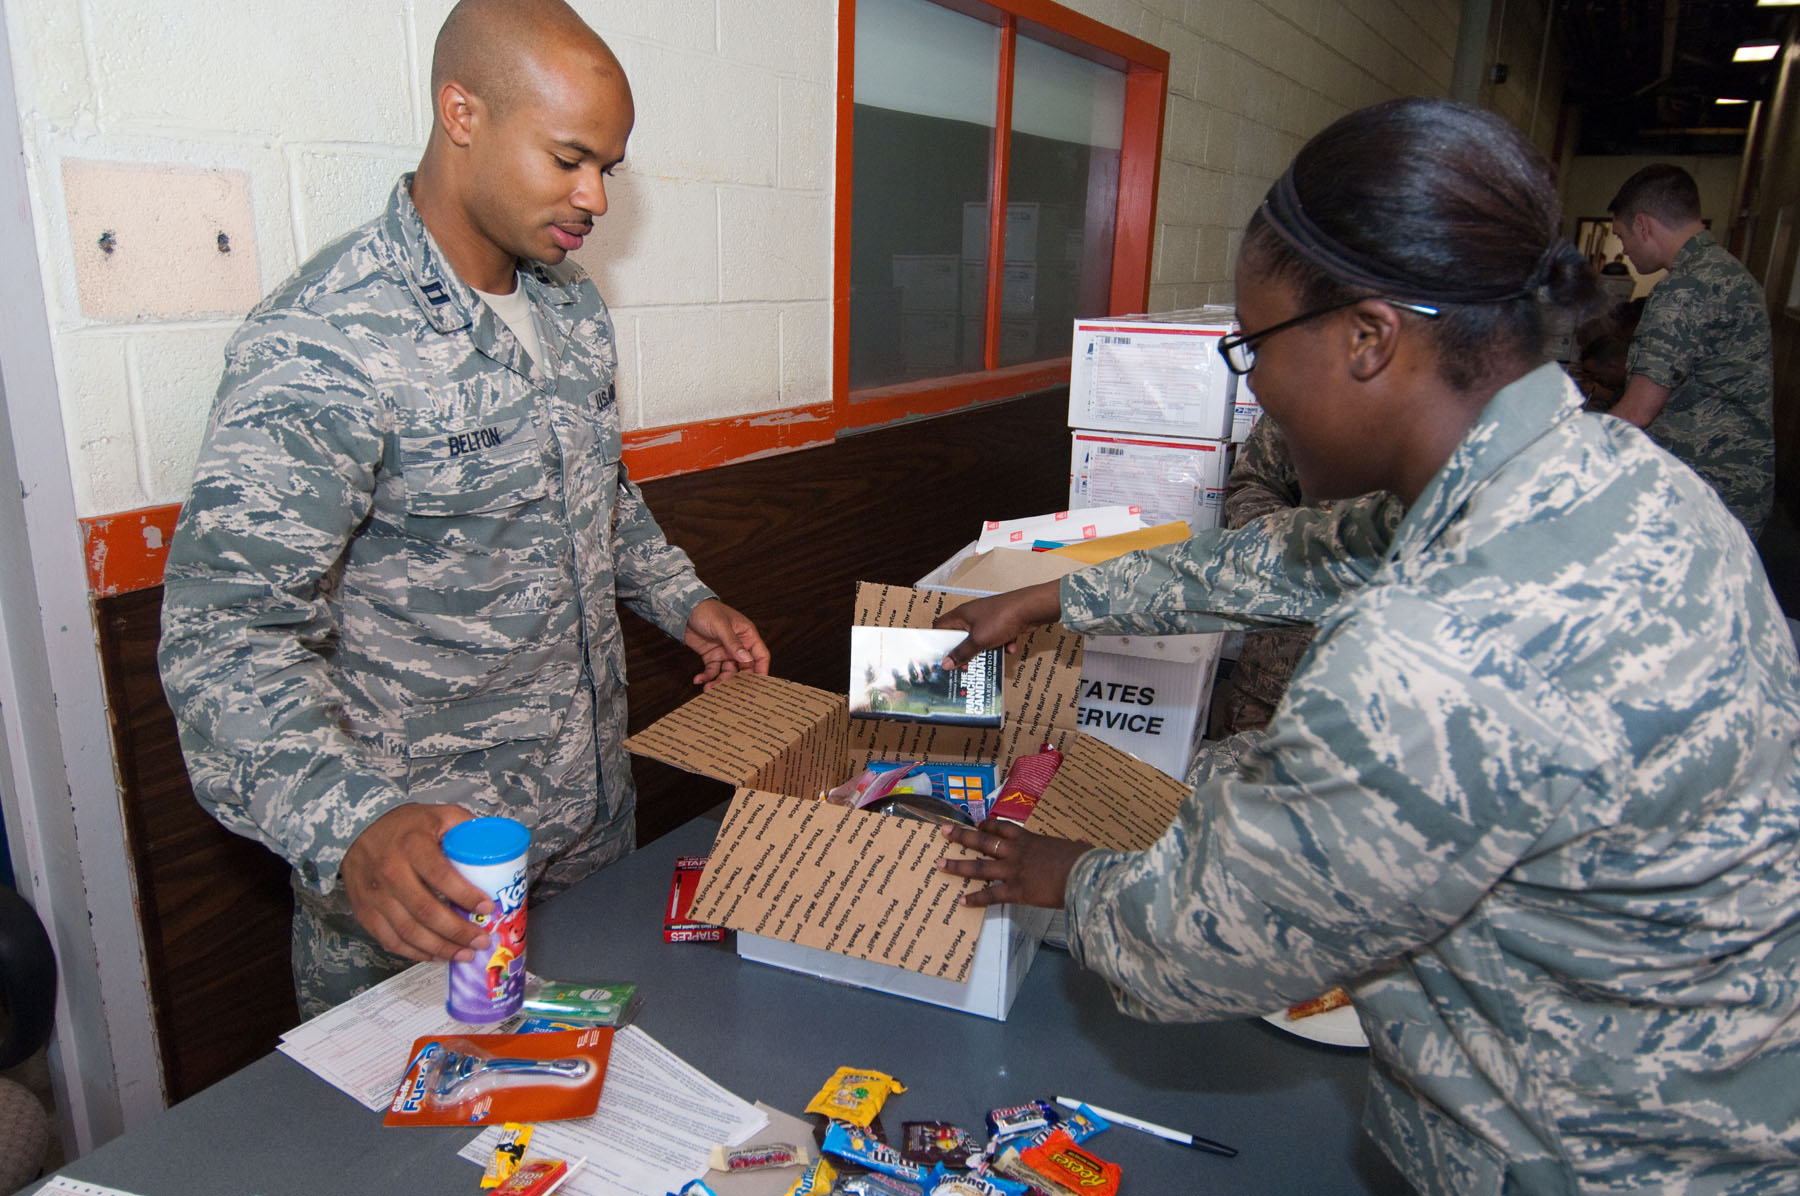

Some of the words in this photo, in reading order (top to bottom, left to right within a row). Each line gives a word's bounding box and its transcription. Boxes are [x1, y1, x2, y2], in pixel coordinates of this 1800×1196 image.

[448, 427, 502, 456] BELTON
[960, 671, 968, 688] THE
[965, 655, 978, 714] MANCHURIA
[1079, 678, 1155, 706] TATES
[1050, 693, 1063, 721] required
[1077, 707, 1164, 735] ERVICE
[747, 804, 765, 825] Thank
[755, 810, 778, 840] required
[737, 826, 749, 840] you
[805, 828, 824, 851] Thank
[848, 816, 868, 845] Service
[897, 829, 917, 860] postage
[730, 841, 740, 853] for
[753, 844, 775, 872] Priority
[779, 833, 799, 864] postage
[796, 851, 808, 866] you
[814, 835, 837, 867] required
[909, 843, 931, 872] Service
[788, 867, 799, 879] for
[840, 860, 860, 892] postage
[867, 855, 885, 878] Thank
[876, 861, 899, 896] required
[757, 865, 780, 899] required
[773, 880, 790, 902] using
[813, 870, 836, 900] Priority
[856, 878, 869, 894] you
[931, 883, 949, 907] Thank
[784, 894, 803, 918] Thank
[819, 893, 841, 928] required
[850, 895, 861, 908] for
[877, 899, 899, 929] Priority
[903, 888, 924, 921] postage
[835, 909, 852, 932] using
[922, 908, 934, 924] you
[671, 930, 720, 942] STAPLES
[847, 923, 865, 949] Thank
[882, 923, 904, 959] required
[915, 925, 926, 938] for
[944, 930, 966, 961] Priority
[900, 939, 917, 963] using
